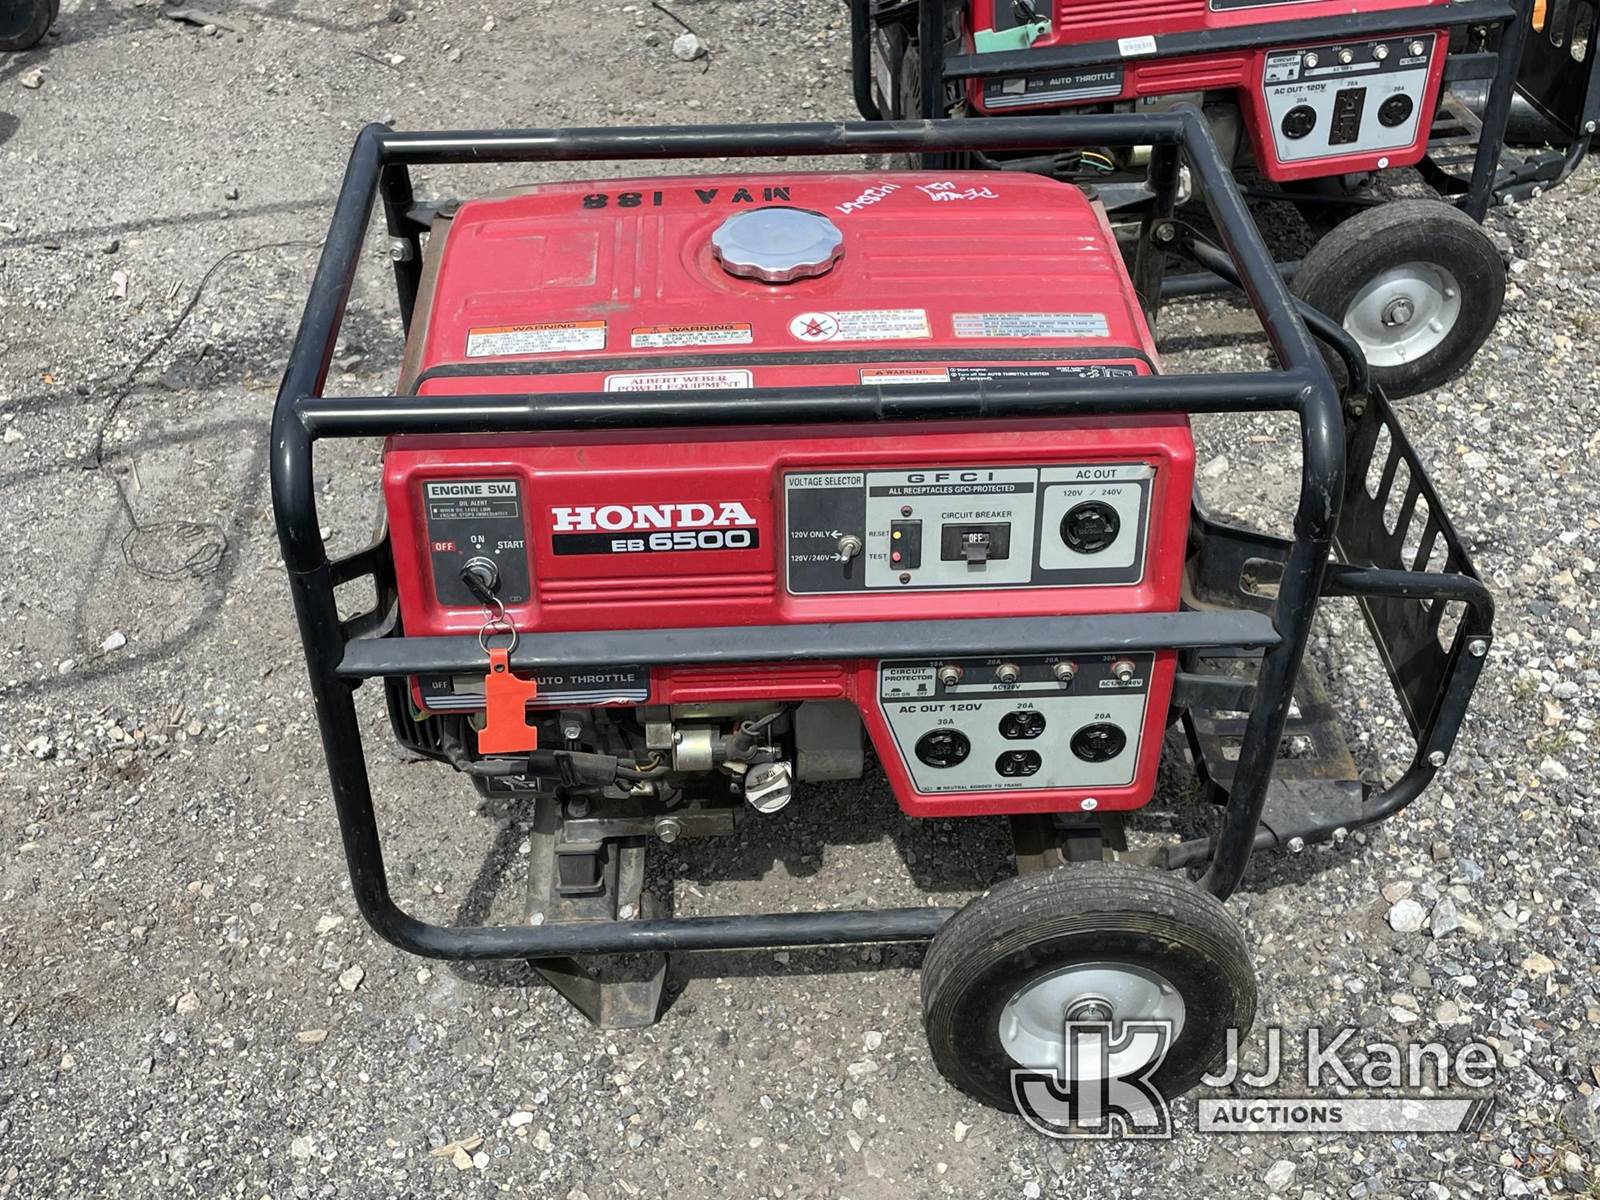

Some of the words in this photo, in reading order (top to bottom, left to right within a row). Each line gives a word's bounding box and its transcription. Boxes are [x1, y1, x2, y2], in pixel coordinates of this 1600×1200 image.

[1272, 56, 1296, 64] CIRCUIT
[1050, 77, 1072, 86] AUTO
[1075, 72, 1116, 83] THROTTLE
[1286, 86, 1303, 94] OUT
[1306, 83, 1327, 91] 120V
[512, 323, 576, 332] WARNING
[668, 324, 734, 332] WARNING
[630, 377, 679, 385] ALBERT
[681, 375, 728, 383] WEBER
[666, 381, 740, 391] EQUIPMENT
[907, 472, 994, 483] GFCI
[1076, 470, 1092, 479] AC
[1094, 469, 1118, 478] OUT
[789, 477, 822, 486] VOLTAGE
[824, 476, 862, 486] SELECTOR
[432, 485, 482, 496] ENGINE
[488, 484, 514, 494] SW.
[888, 487, 904, 495] ALL
[904, 486, 953, 494] RECEPTACLES
[954, 485, 1015, 494] GFCI-PROTECTED
[551, 502, 757, 531] HONDA
[941, 512, 973, 520] CIRCUIT
[975, 510, 1012, 519] BREAKER
[809, 530, 831, 538] ONLY
[968, 533, 984, 543] OFF
[470, 535, 485, 544] ON
[611, 539, 645, 552] EB
[649, 530, 751, 550] 6500
[435, 542, 453, 551] OFF
[497, 540, 524, 550] START
[569, 673, 635, 684] THROTTLE
[884, 674, 933, 682] PROTECTOR
[432, 681, 448, 689] OFF
[899, 706, 916, 714] AC
[920, 704, 946, 712] OUT
[950, 703, 983, 711] 120V
[938, 718, 954, 726] 30A
